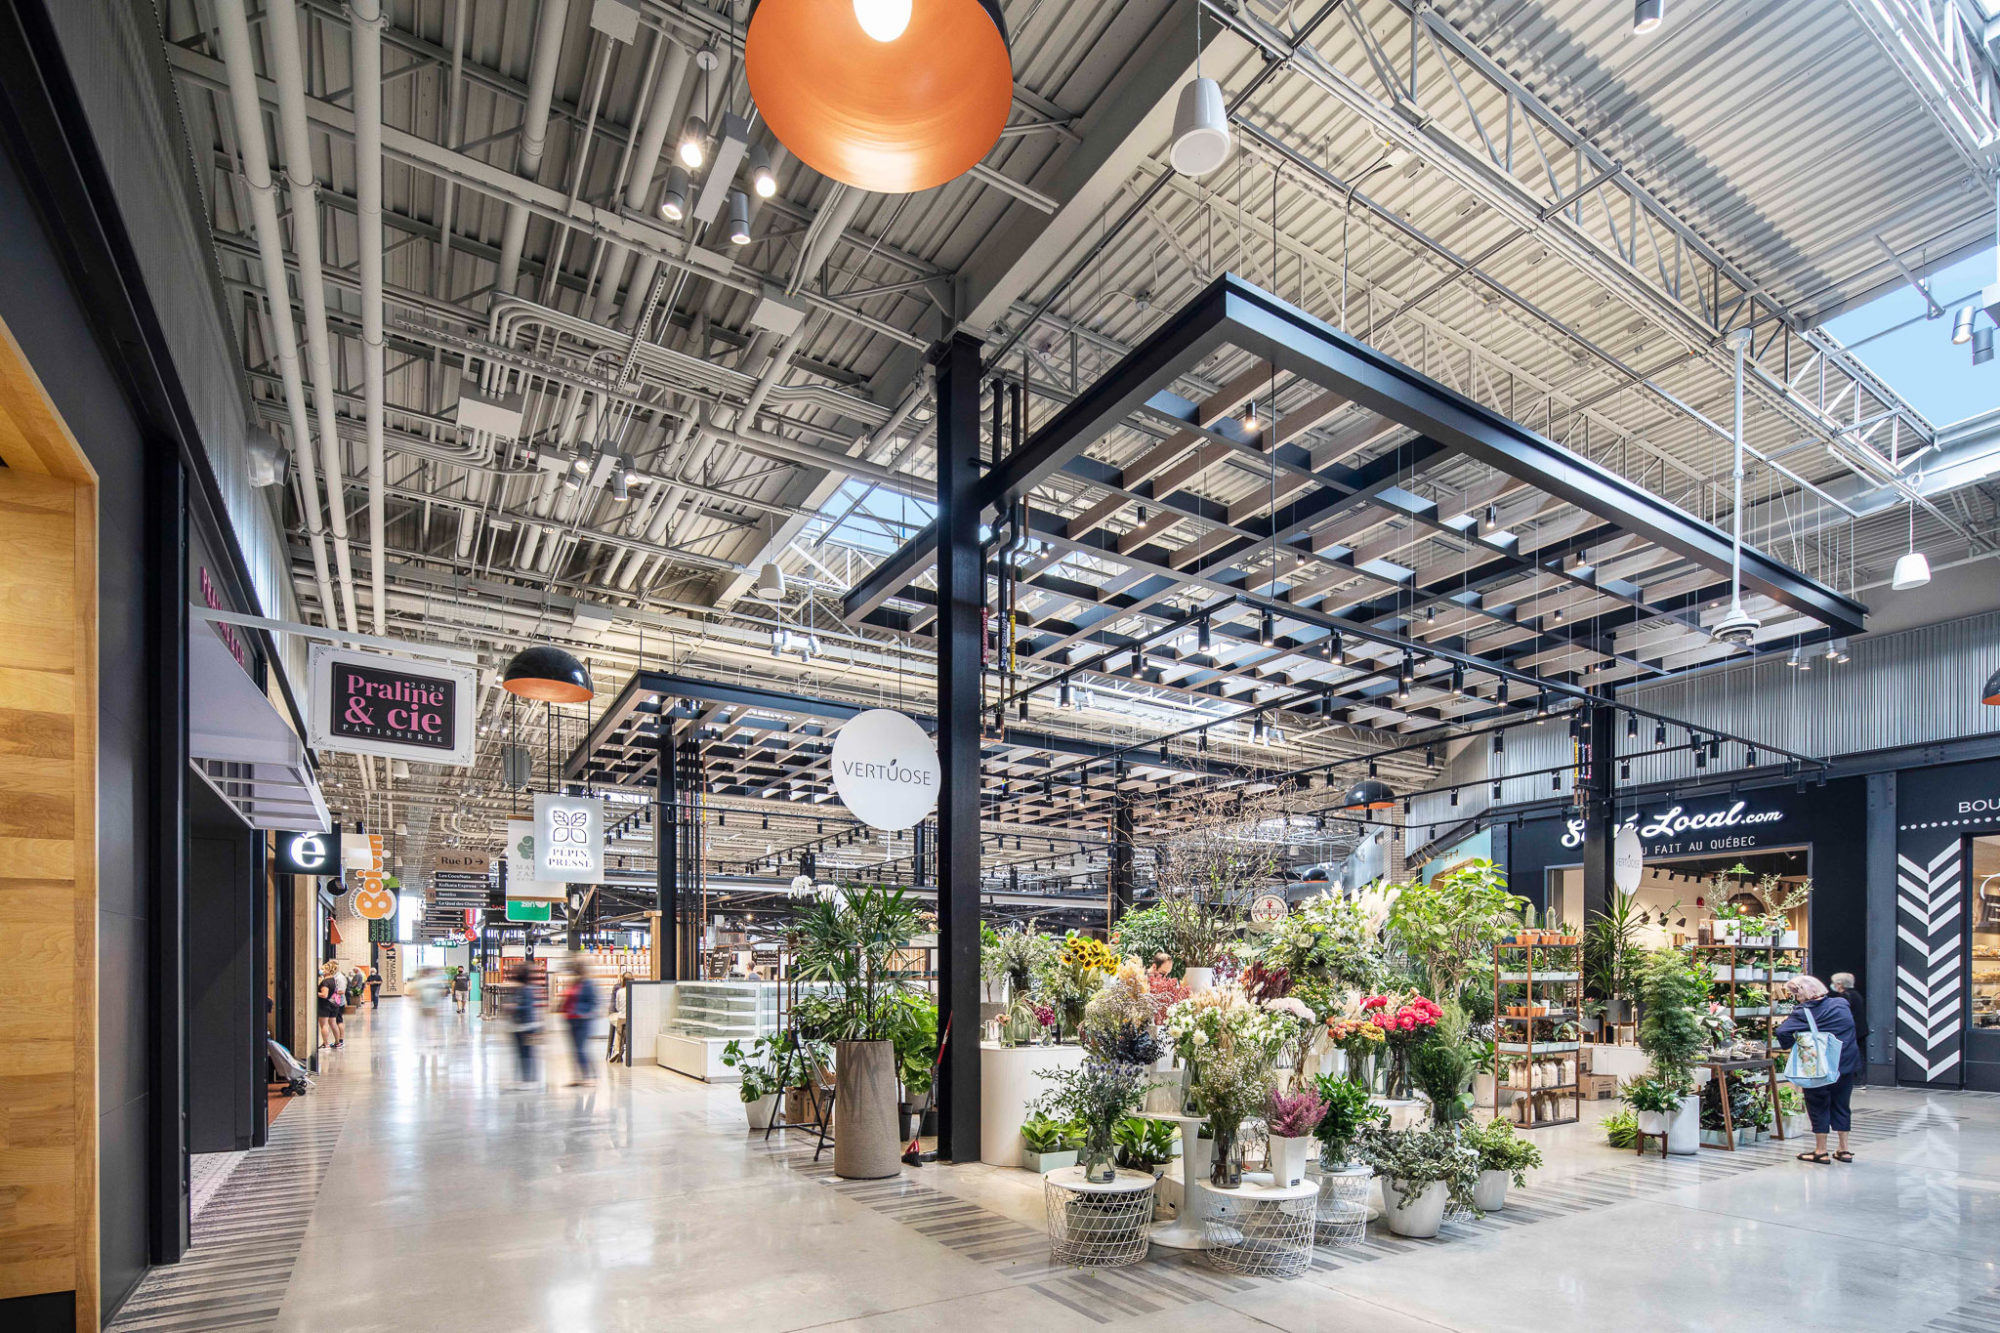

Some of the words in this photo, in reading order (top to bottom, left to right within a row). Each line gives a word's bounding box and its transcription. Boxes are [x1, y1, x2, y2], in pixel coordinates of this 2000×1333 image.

[346, 674, 444, 707] Praline
[344, 696, 375, 726] &
[387, 703, 442, 734] cie
[342, 723, 443, 743] PÂTISSERIE
[1640, 801, 1784, 838] Local.com
[553, 846, 588, 858] PÉPIN
[1655, 843, 1682, 855] FAIT
[1688, 841, 1703, 852] AU
[1710, 836, 1756, 850] QUÉBEC
[441, 856, 461, 866] Rue
[464, 857, 473, 866] D
